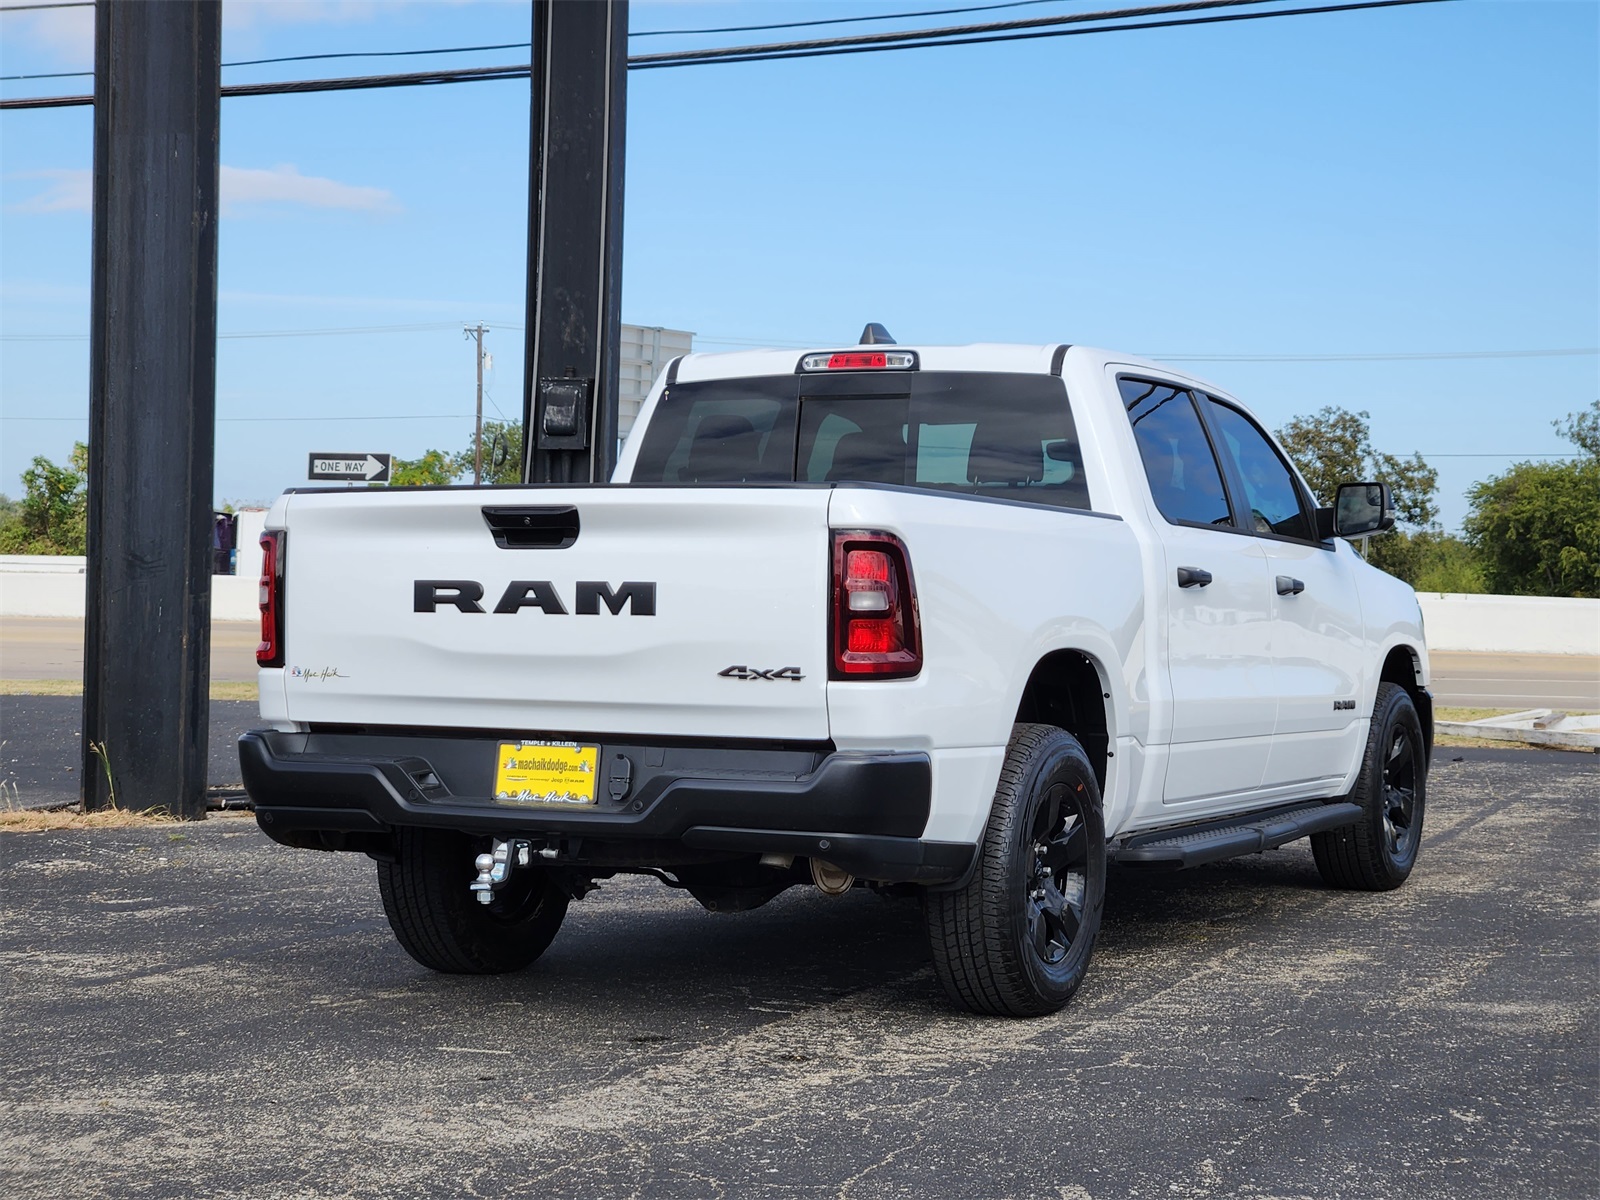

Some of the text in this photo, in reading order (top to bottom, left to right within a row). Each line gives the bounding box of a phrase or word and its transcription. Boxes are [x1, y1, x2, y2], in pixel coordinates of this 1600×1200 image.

[320, 461, 365, 473] ONE WAY
[414, 580, 657, 616] RAM
[717, 665, 807, 681] 4x4
[517, 759, 578, 774] machaikdodge.com
